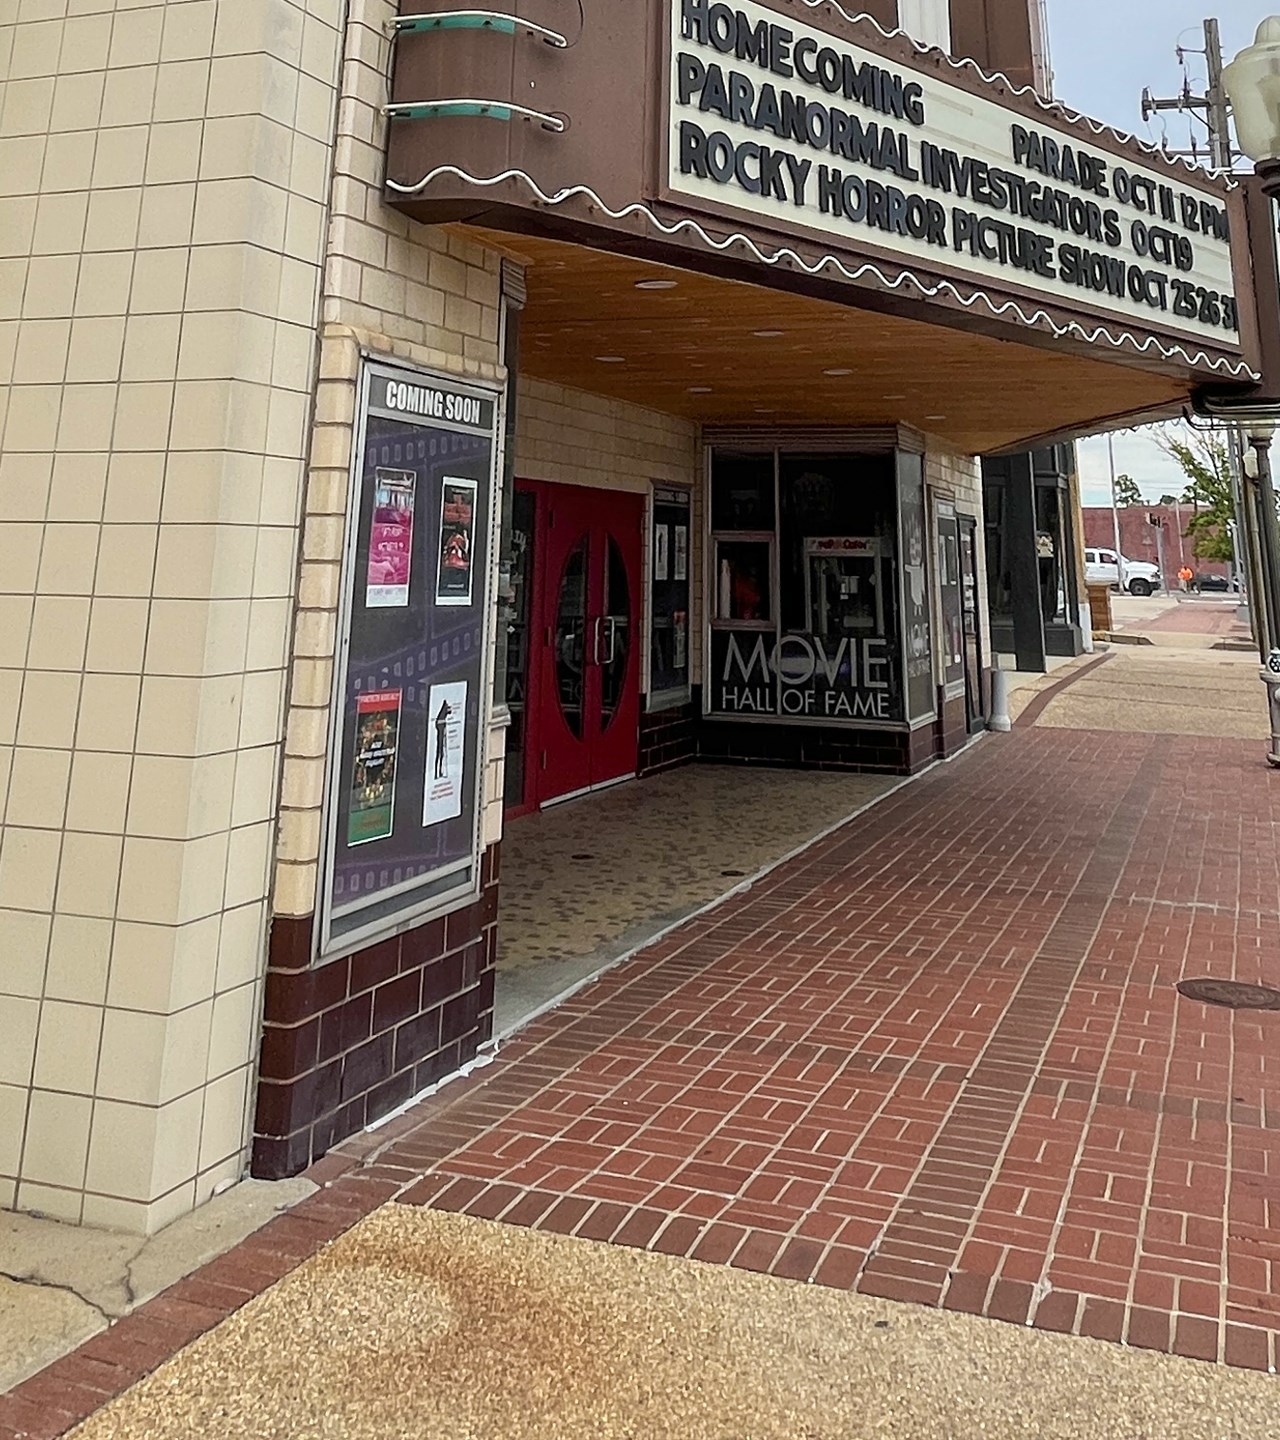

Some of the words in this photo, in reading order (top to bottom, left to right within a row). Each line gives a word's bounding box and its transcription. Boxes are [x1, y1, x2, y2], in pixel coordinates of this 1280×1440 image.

[678, 52, 918, 181] PARANORMAL
[921, 140, 1122, 247] INVESTIGATORS
[1011, 124, 1109, 198] PARADE
[1113, 167, 1157, 216] OCT
[1159, 183, 1177, 223] 11
[1180, 193, 1200, 232] 12
[680, 120, 812, 206] ROCKY
[819, 164, 948, 247] HORROR
[952, 207, 1057, 278] PICTURE
[1058, 243, 1126, 298] SHOW
[1128, 264, 1169, 311] OCT
[1171, 279, 1198, 319] 25
[1196, 286, 1221, 325] 26
[386, 381, 444, 417] COMING
[445, 394, 480, 424] SOON
[723, 632, 888, 688] MOVIE
[722, 686, 774, 711] HALL
[782, 689, 815, 714] OF
[825, 691, 890, 718] FAME
